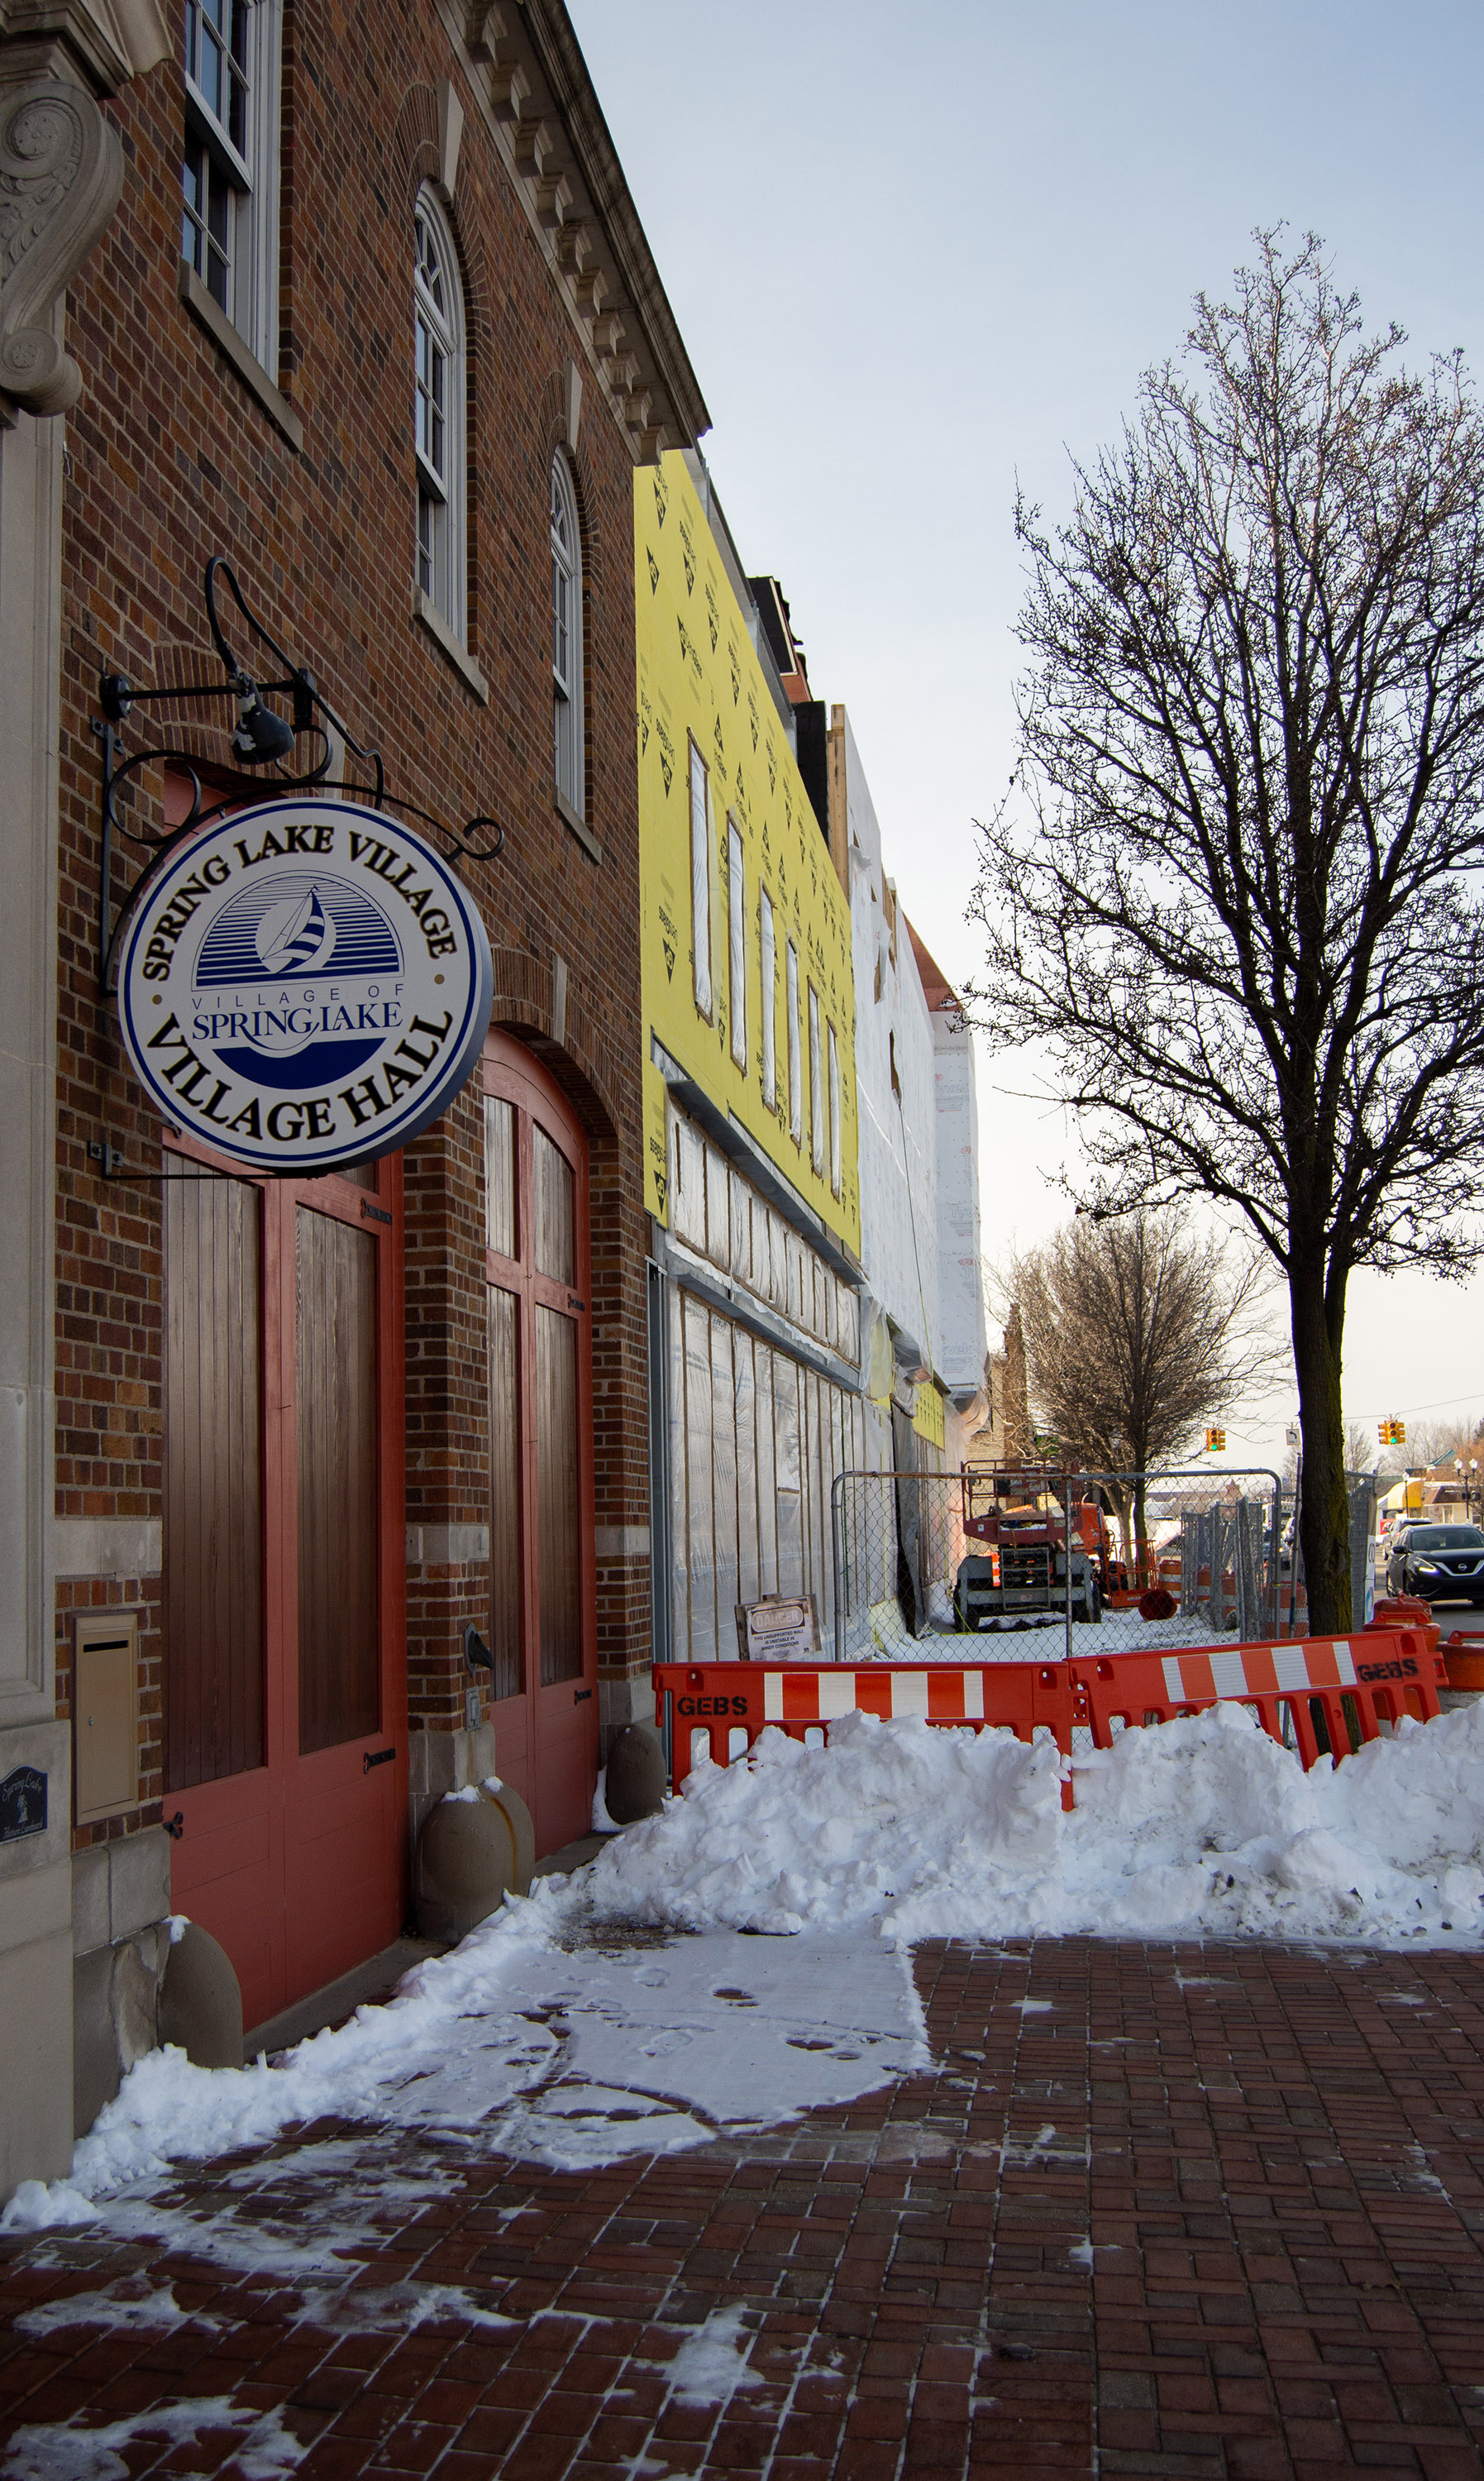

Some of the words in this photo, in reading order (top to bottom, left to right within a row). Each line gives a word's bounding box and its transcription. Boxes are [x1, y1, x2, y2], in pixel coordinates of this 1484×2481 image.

[142, 854, 231, 982] SPRING
[233, 825, 335, 868] LAKE
[348, 830, 458, 960] VILLAGE
[192, 987, 340, 1010] VILLAGE
[368, 983, 404, 998] OF
[192, 1006, 321, 1051] SPRING
[320, 1001, 403, 1033] LAKE
[146, 1011, 336, 1141] VILLAGE
[337, 1010, 454, 1128] HALL
[769, 1637, 790, 1645] UNSTABLE
[775, 1640, 799, 1649] CONDITIONS
[1358, 1658, 1419, 1682] GEBS
[677, 1695, 748, 1716] GEBS
[2, 1778, 25, 1802] Spring
[25, 1771, 43, 1793] Lake
